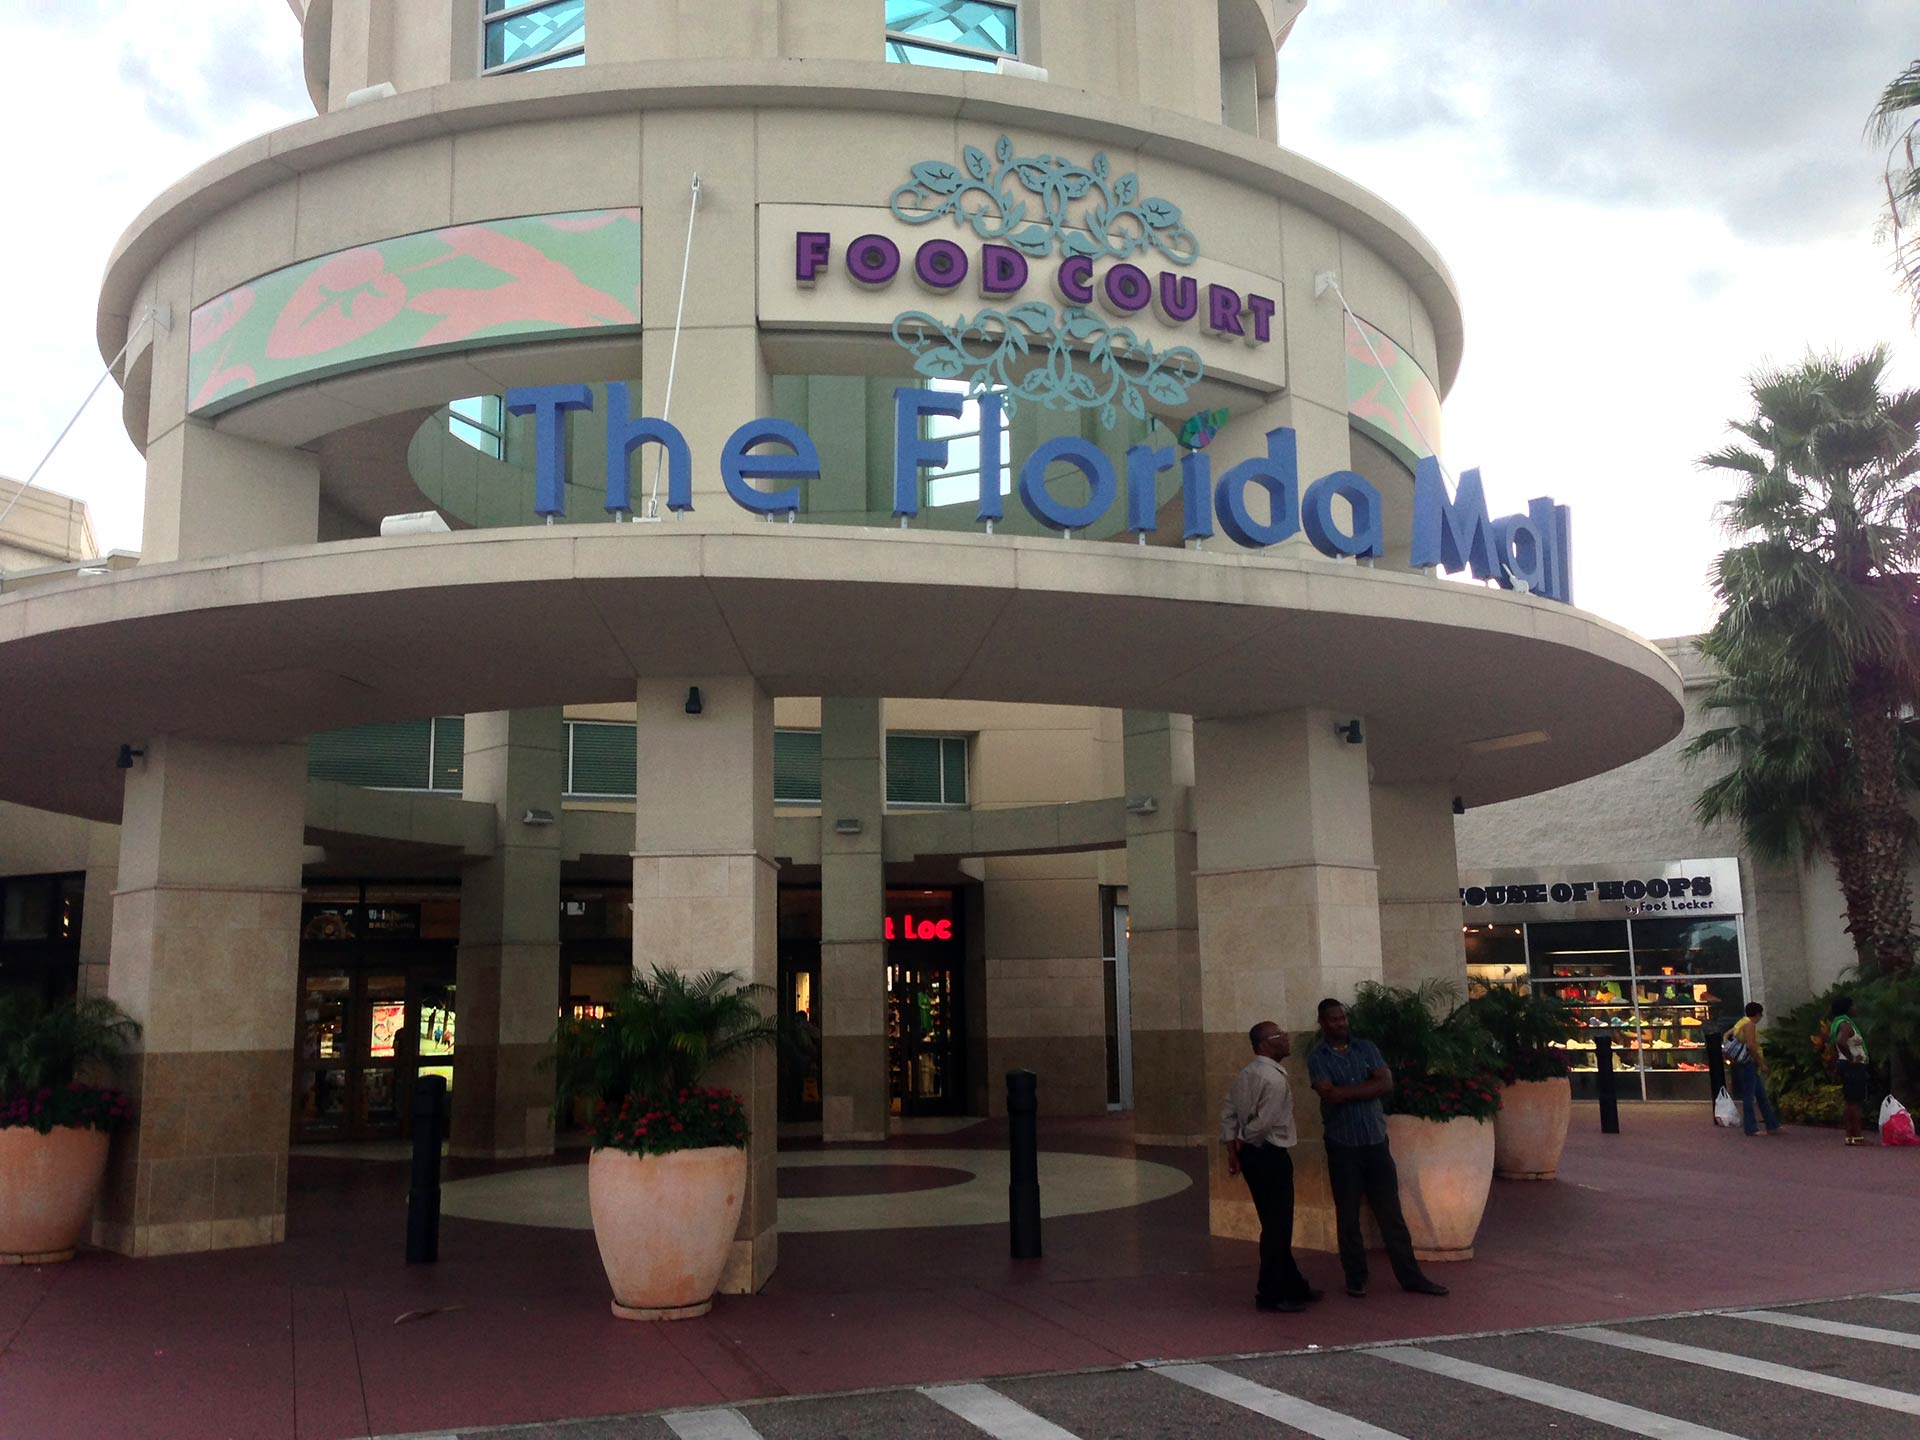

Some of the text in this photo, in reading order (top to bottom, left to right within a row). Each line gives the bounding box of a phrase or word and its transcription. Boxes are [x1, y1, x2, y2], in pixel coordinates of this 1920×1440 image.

[795, 231, 1275, 345] FOOD COURT
[506, 381, 1575, 604] The Florida Mall
[1550, 882, 1595, 903] OF
[1597, 876, 1712, 901] HOOPS
[1625, 898, 1714, 915] by Foot Locker
